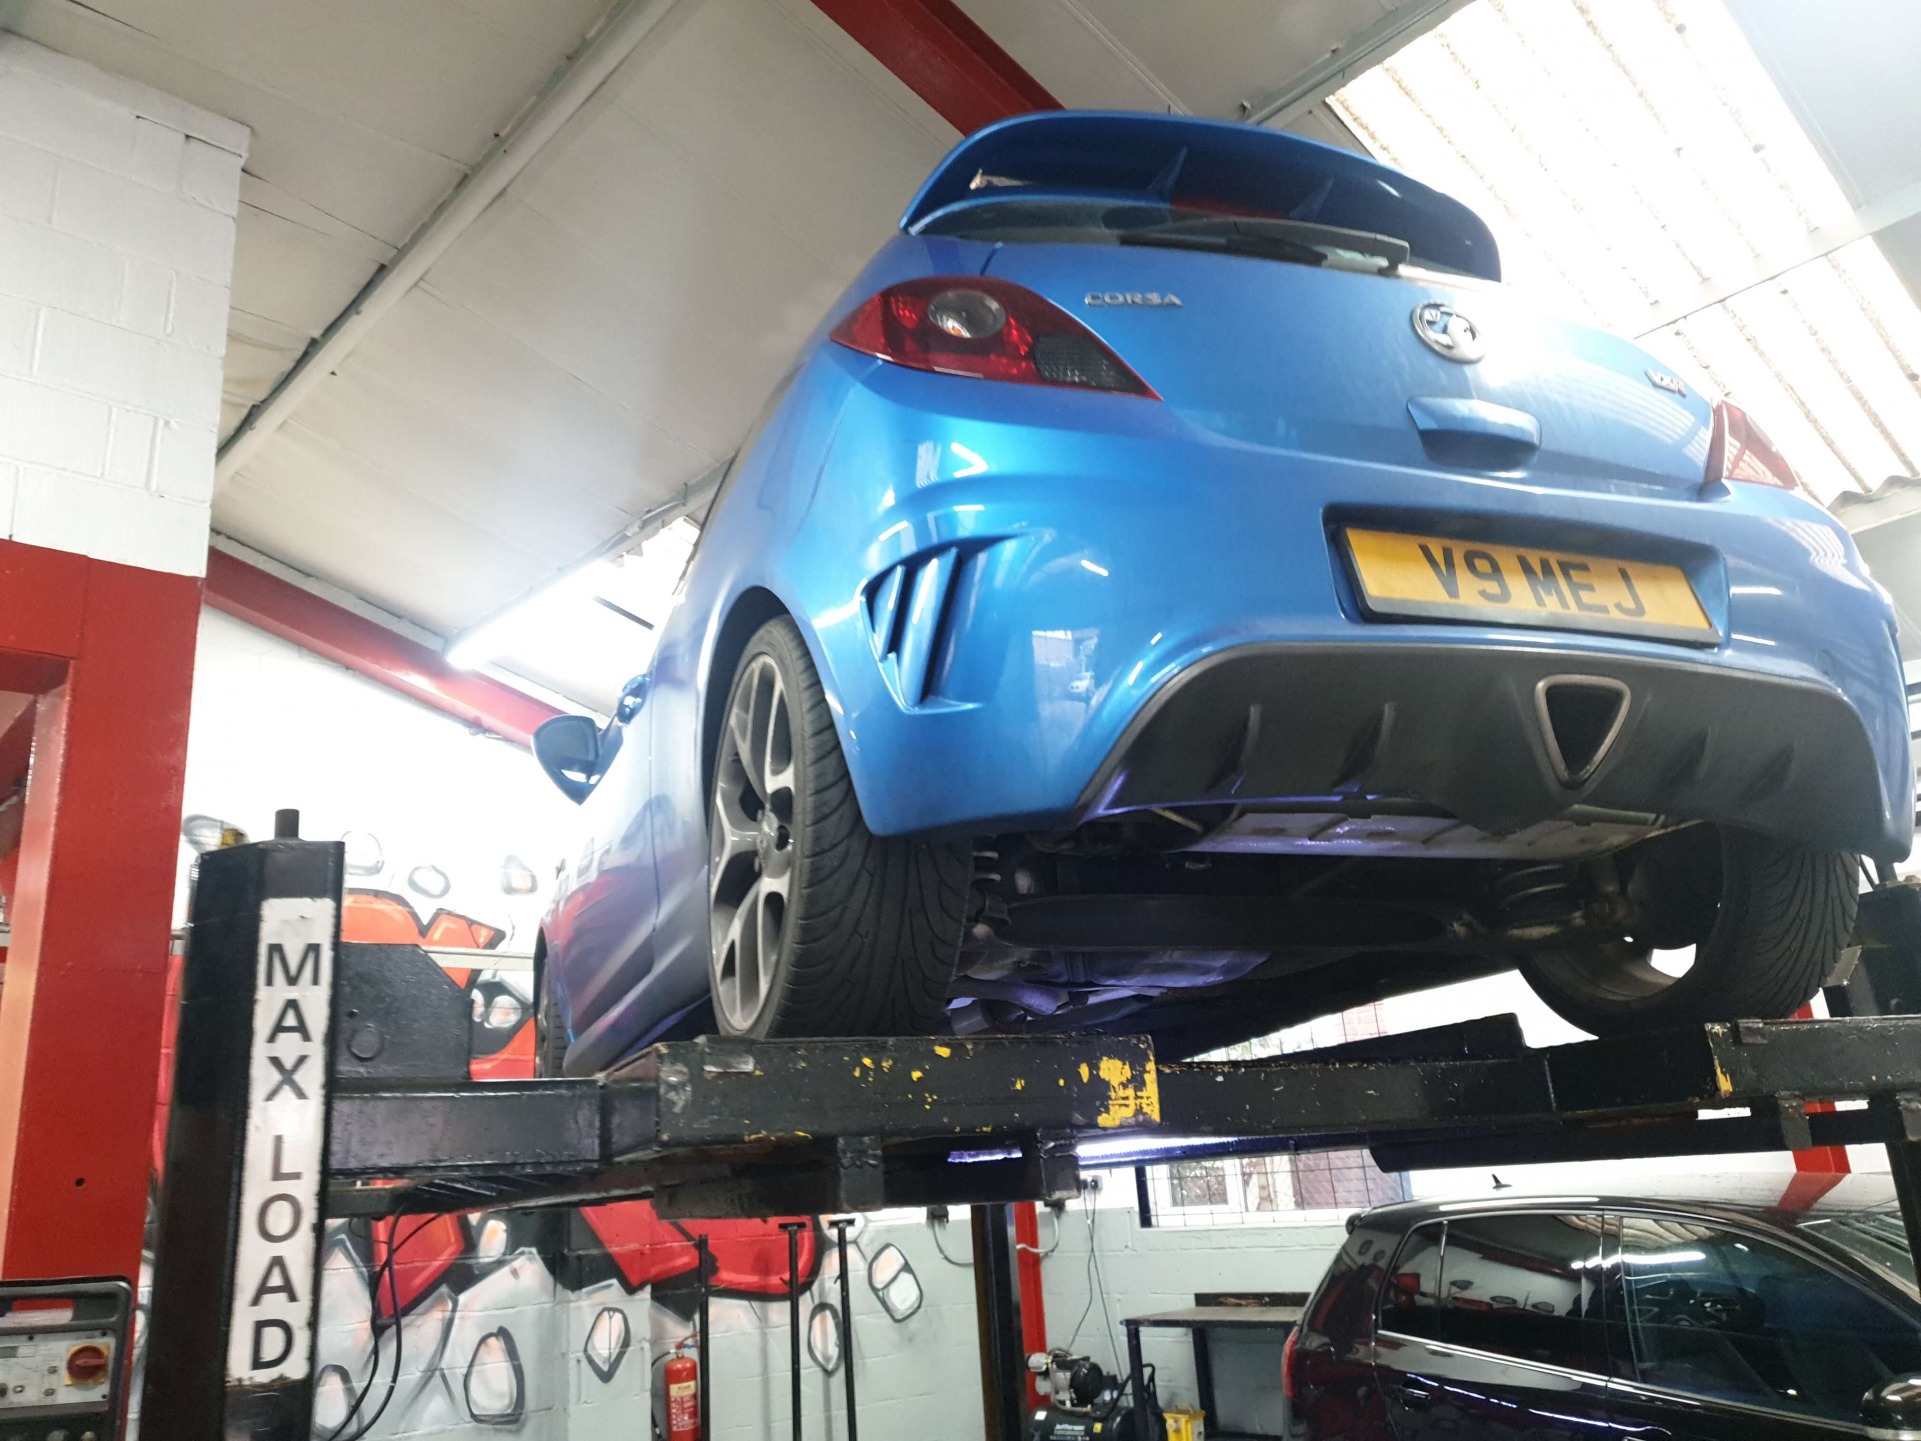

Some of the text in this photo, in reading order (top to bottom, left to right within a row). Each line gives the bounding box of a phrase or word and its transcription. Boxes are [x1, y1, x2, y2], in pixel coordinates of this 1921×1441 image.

[1085, 292, 1182, 307] CORSA
[1418, 543, 1646, 618] V9 MEJ
[248, 943, 321, 1371] MAX LOAD
